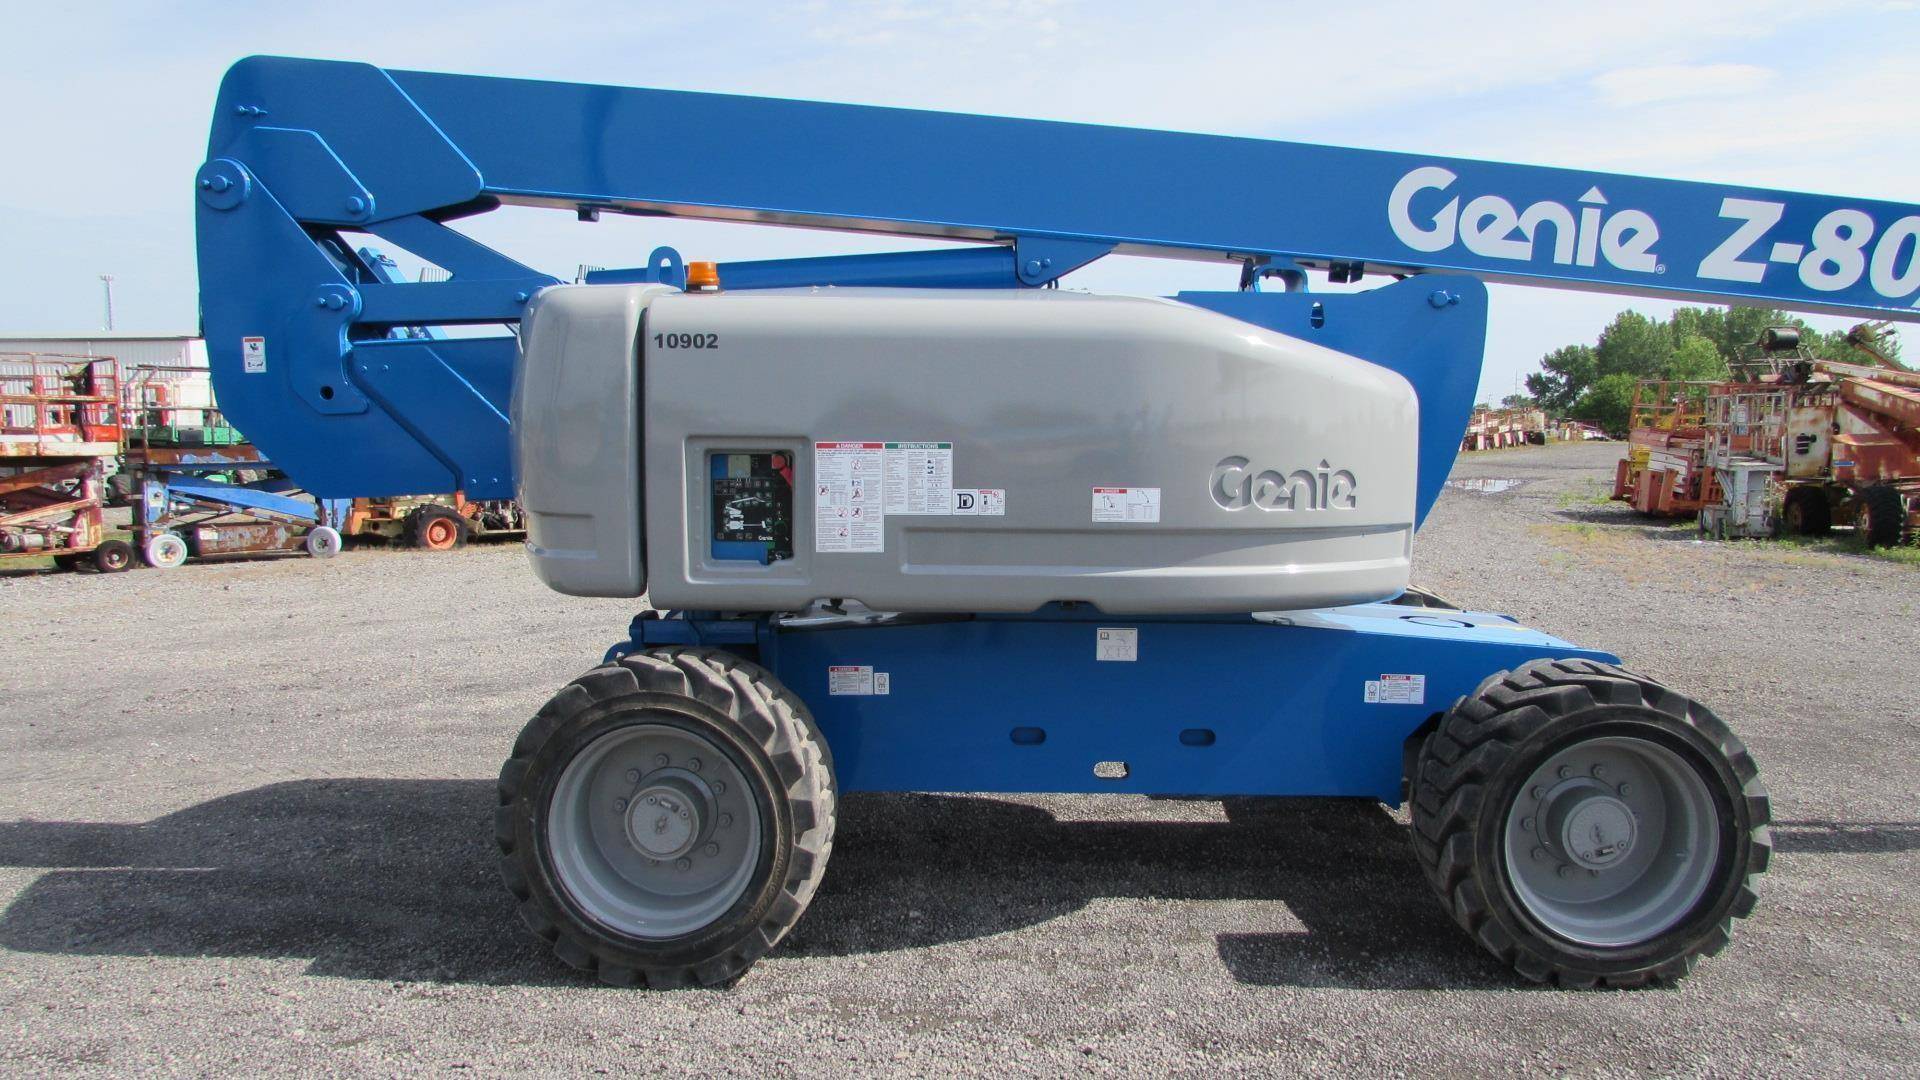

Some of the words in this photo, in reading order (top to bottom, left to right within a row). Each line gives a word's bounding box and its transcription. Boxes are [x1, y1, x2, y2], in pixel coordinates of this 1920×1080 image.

[1388, 166, 1659, 273] Genie
[1697, 197, 1920, 308] Z-80
[654, 333, 718, 349] 10902
[1209, 455, 1357, 511] Genie
